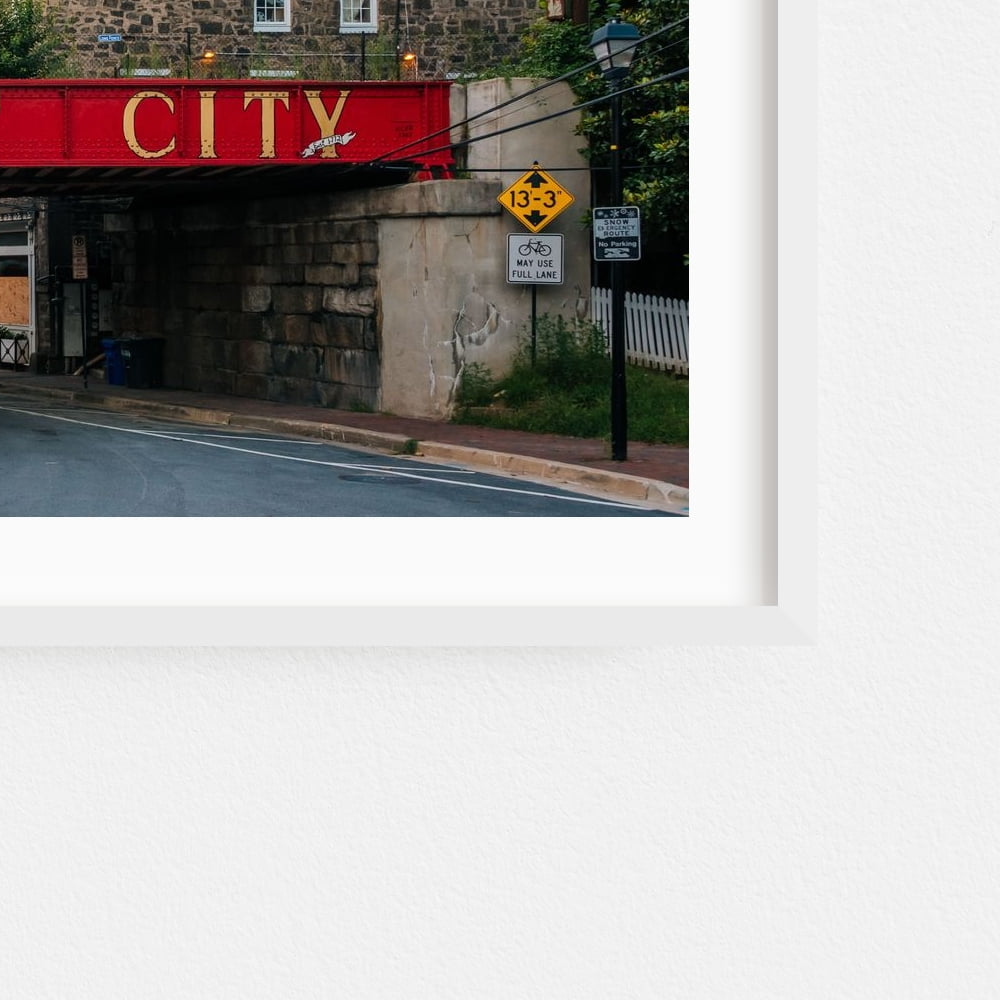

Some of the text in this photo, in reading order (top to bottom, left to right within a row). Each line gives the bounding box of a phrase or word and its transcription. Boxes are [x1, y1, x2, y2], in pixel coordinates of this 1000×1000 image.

[122, 90, 351, 158] CITY
[610, 240, 638, 248] Parking
[516, 259, 553, 268] MAY USE
[512, 270, 558, 279] FULL LANE
